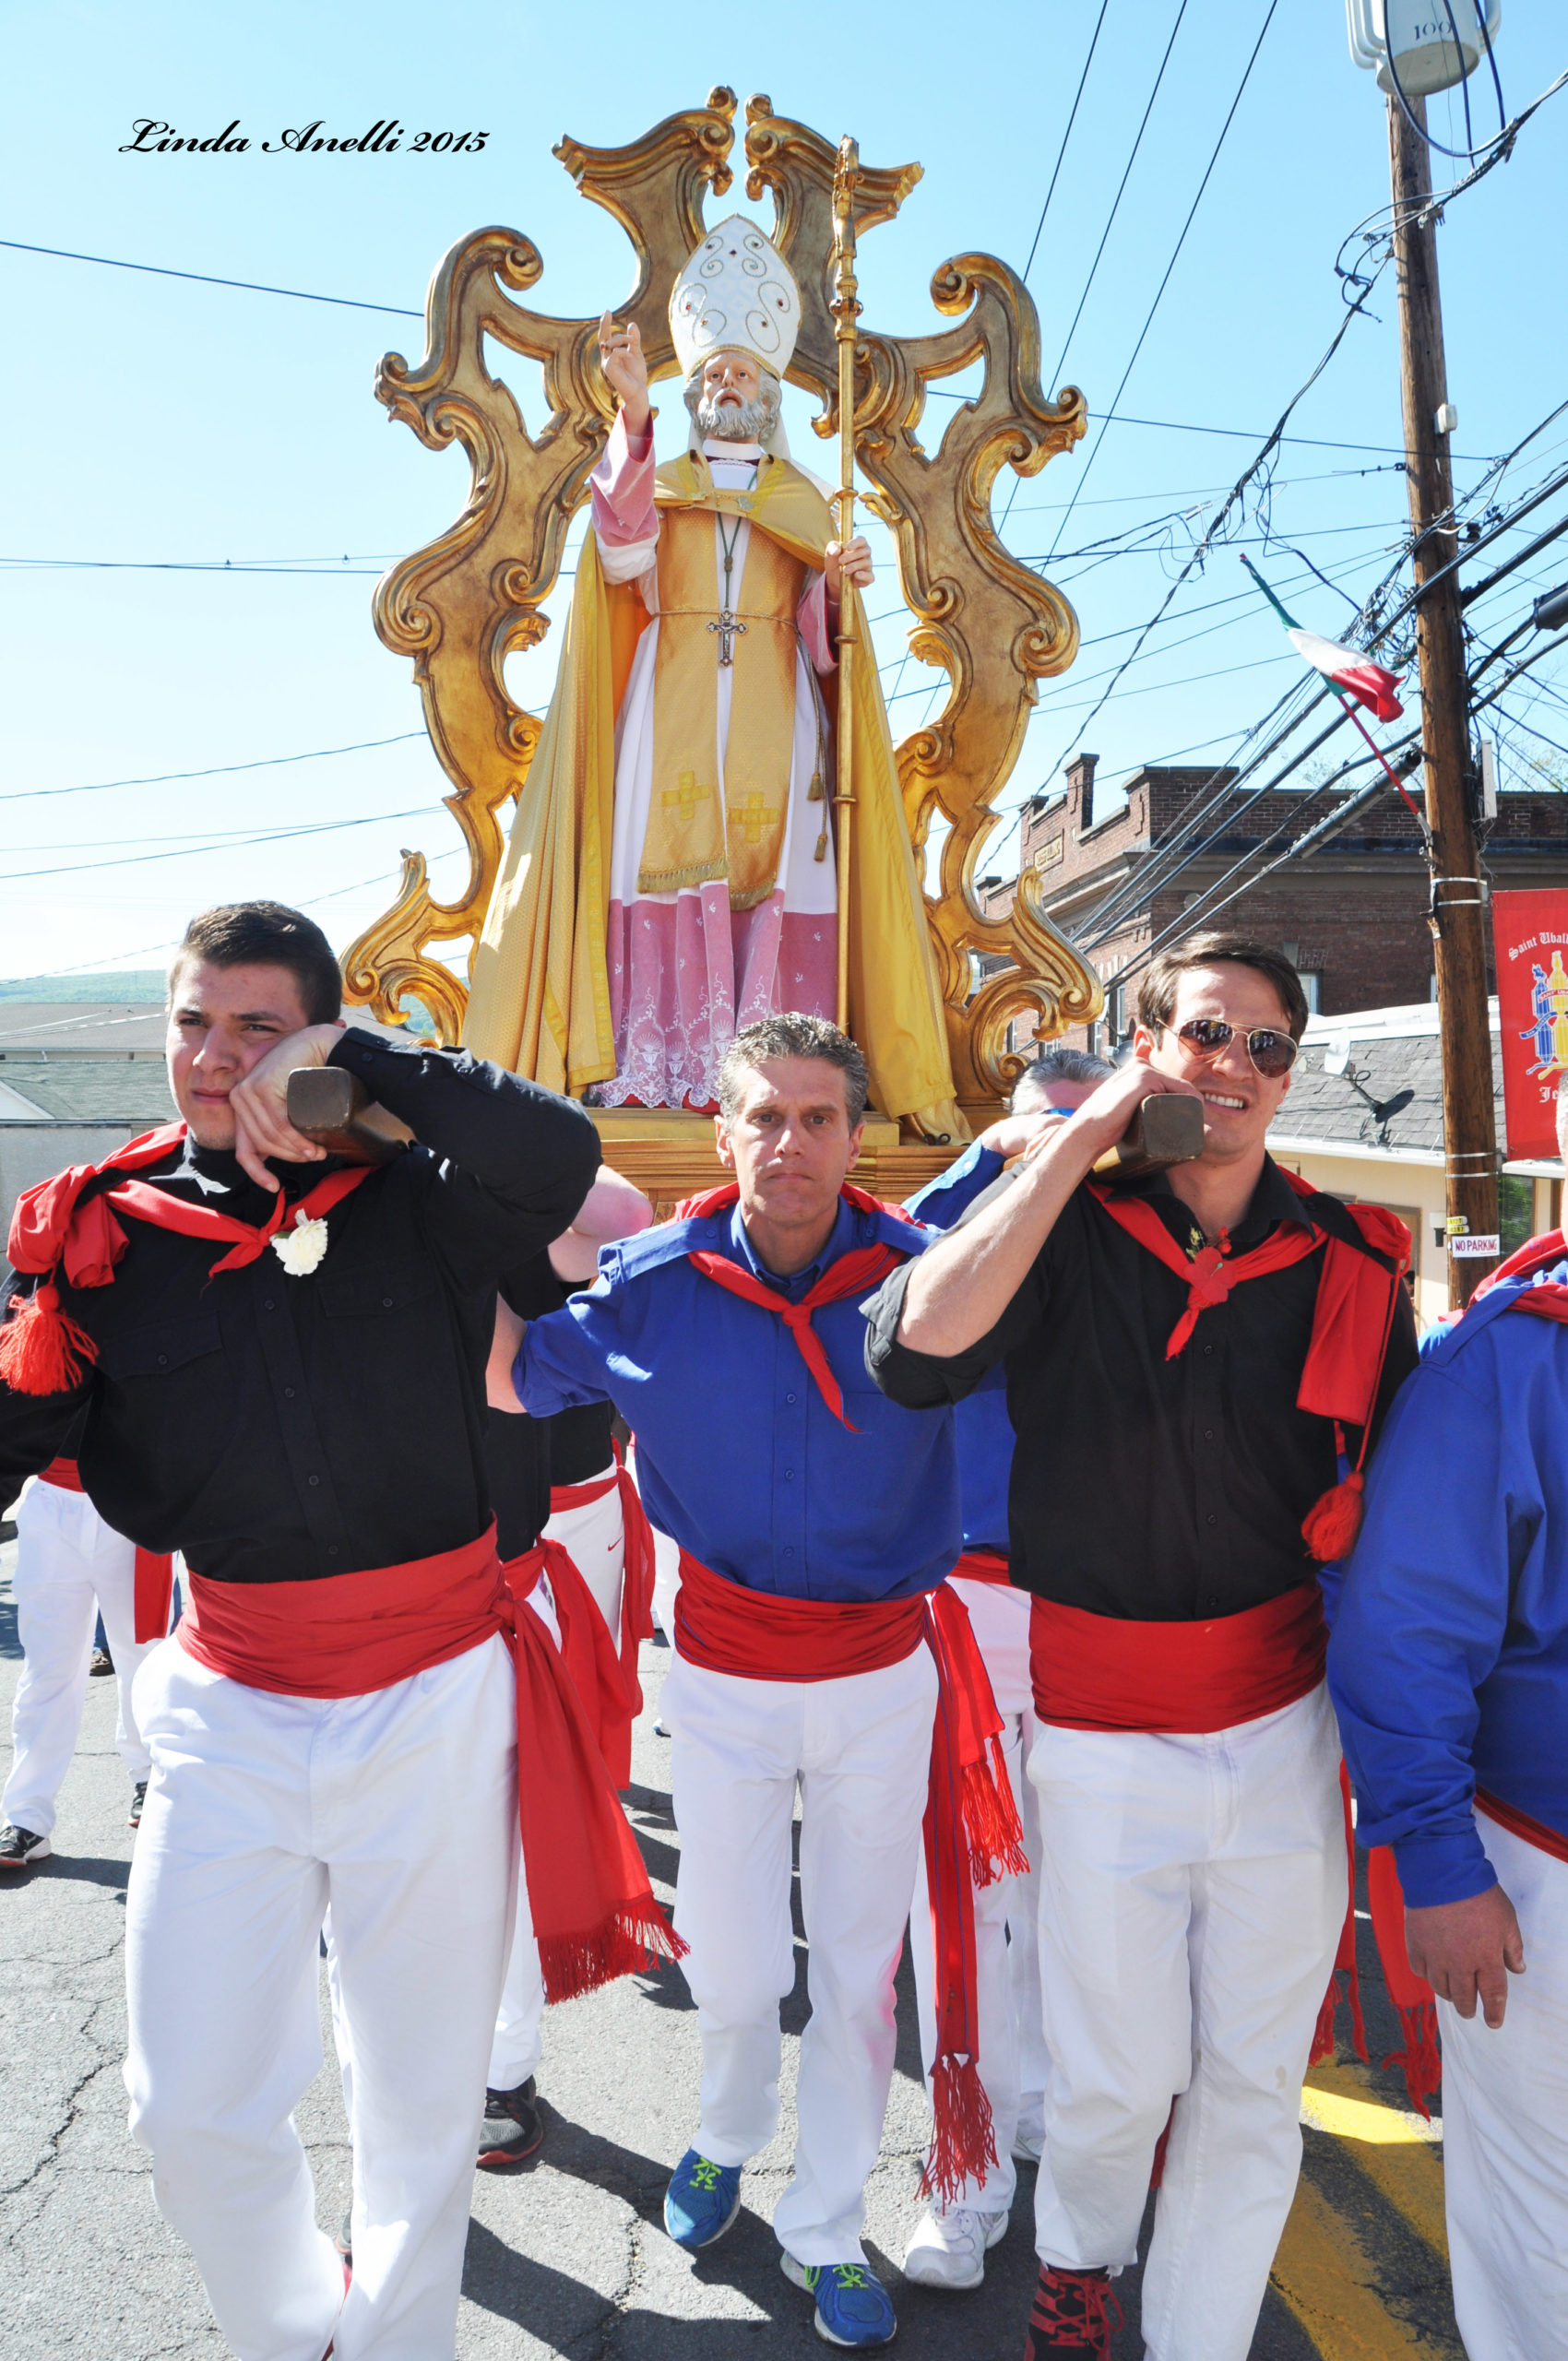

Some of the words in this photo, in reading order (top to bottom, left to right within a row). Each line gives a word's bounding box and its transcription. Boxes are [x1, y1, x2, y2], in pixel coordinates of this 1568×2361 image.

[1414, 21, 1453, 41] 100
[1508, 937, 1538, 961] Saint
[1539, 931, 1568, 944] Ubal
[1455, 1240, 1466, 1252] NO
